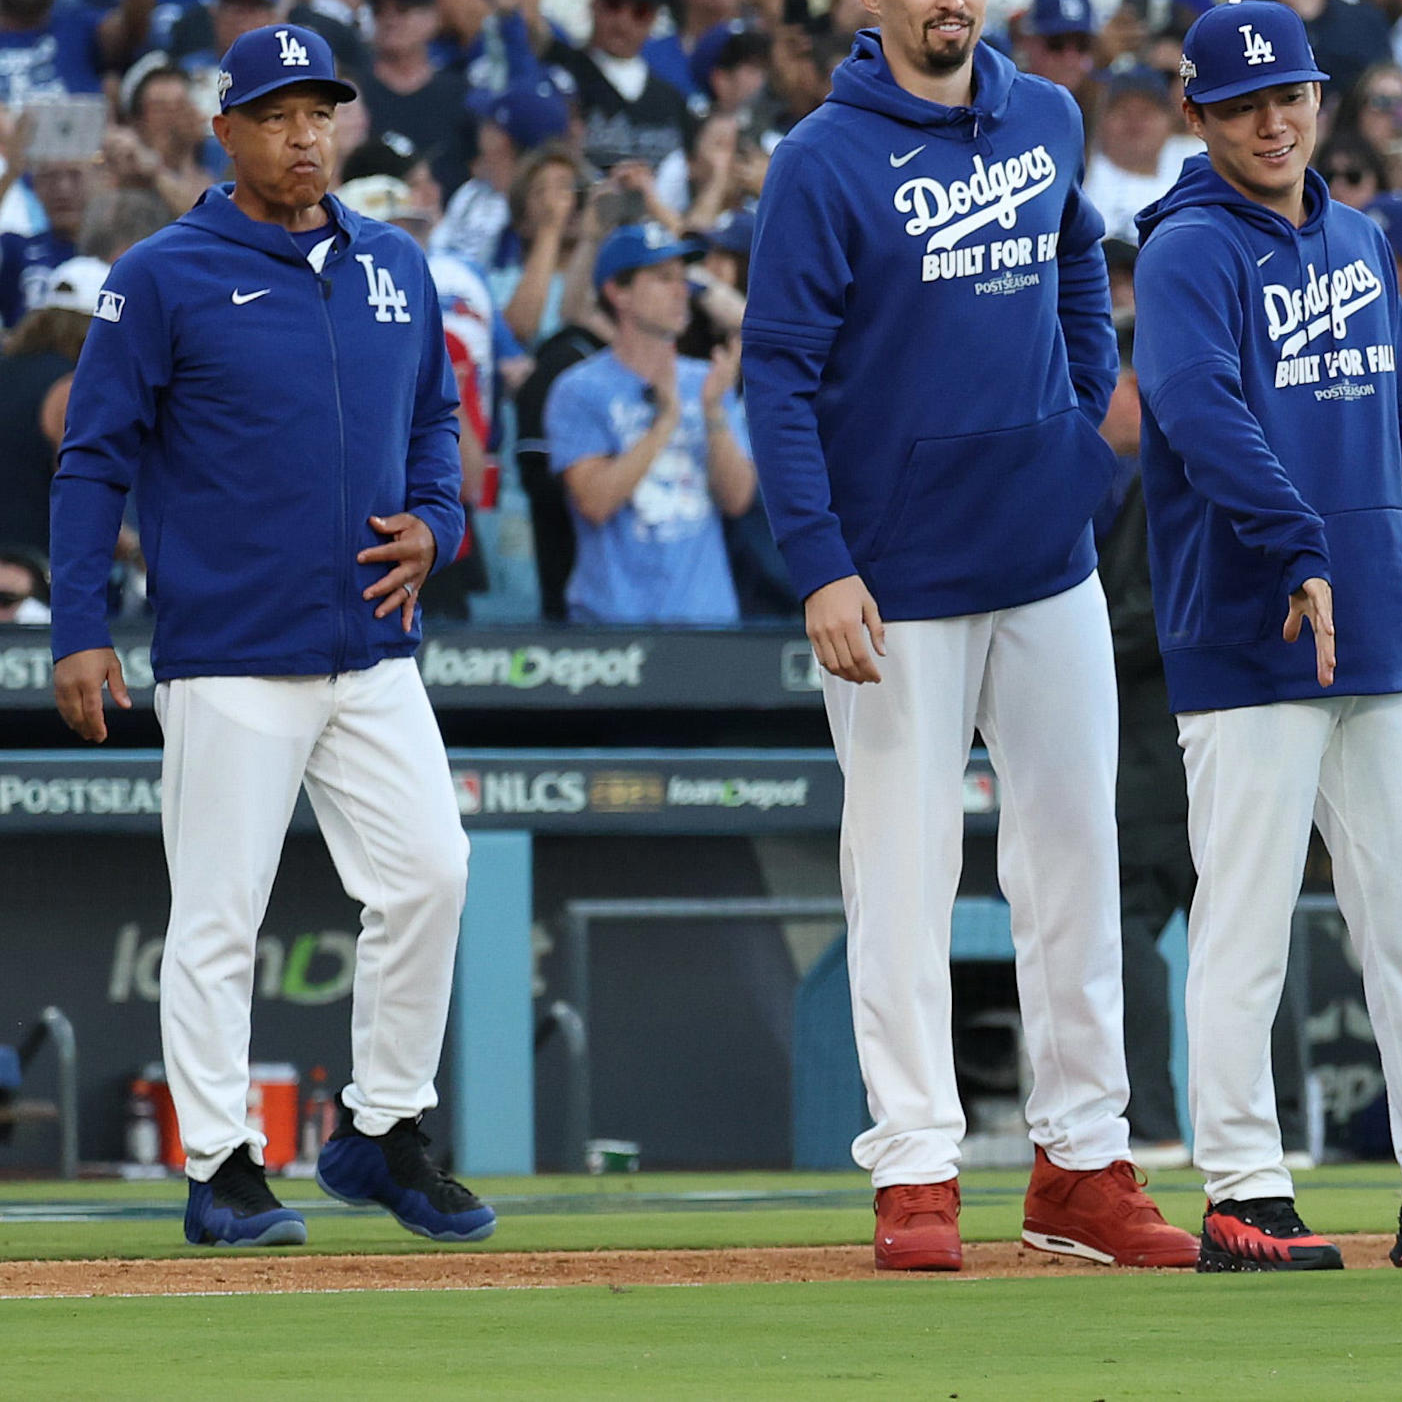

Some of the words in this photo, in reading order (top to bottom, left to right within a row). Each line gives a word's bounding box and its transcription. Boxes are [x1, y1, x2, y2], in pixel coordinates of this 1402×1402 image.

[274, 30, 310, 67] LA
[1238, 24, 1277, 66] LA
[894, 144, 1057, 253] Dodgers
[921, 244, 986, 282] BUILT
[990, 235, 1034, 271] FOR
[355, 253, 412, 324] LA
[974, 273, 1040, 295] POSTSEASON
[1263, 258, 1383, 358] Dodgers
[1274, 355, 1321, 389] BUILT
[1314, 384, 1376, 402] POSTSEASON
[0, 773, 163, 815] POSTSEA
[485, 771, 587, 814] NLCS
[667, 775, 809, 811] loanDepot
